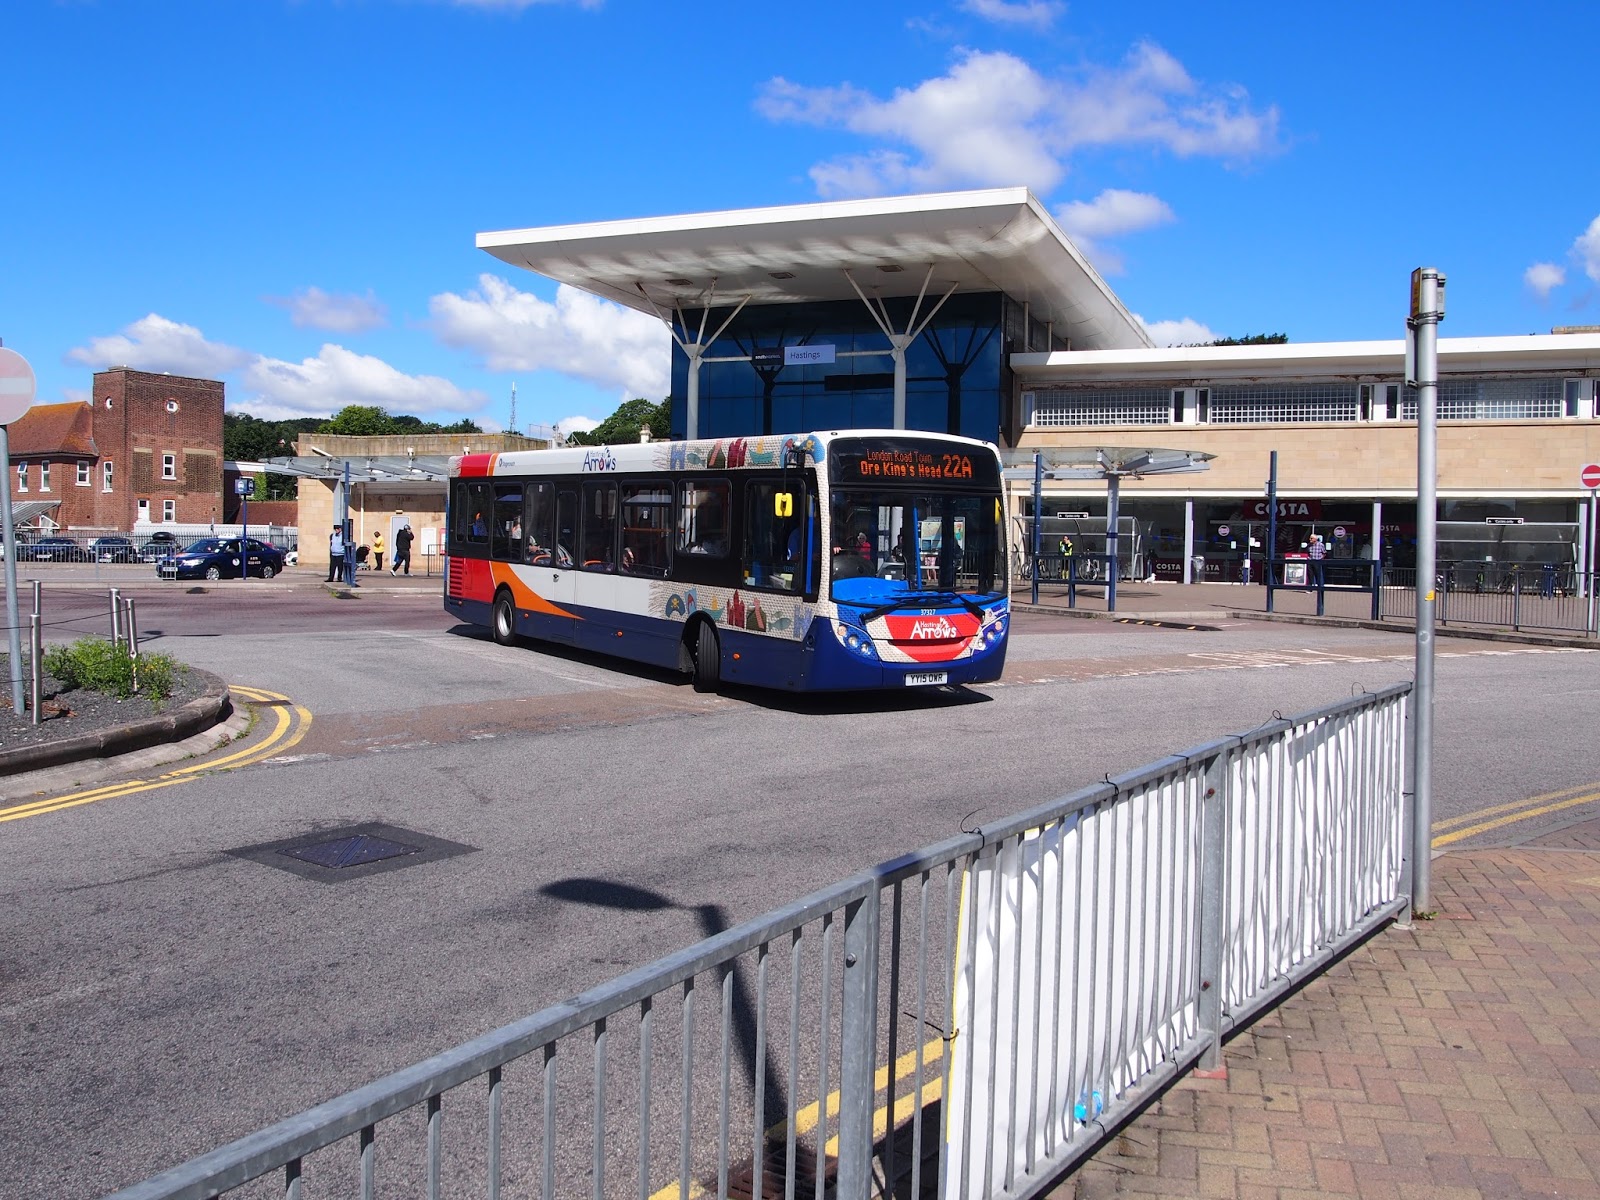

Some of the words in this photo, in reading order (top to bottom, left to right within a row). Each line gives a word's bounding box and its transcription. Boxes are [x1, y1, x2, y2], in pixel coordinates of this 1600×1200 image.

[790, 351, 821, 360] Hastings
[867, 449, 893, 461] London
[894, 450, 912, 463] Road
[860, 460, 881, 475] Ore
[882, 462, 915, 477] King's
[918, 463, 942, 478] Head
[943, 454, 972, 479] 22A
[1380, 524, 1400, 532] OSTA
[910, 620, 957, 639] Arrows
[910, 674, 927, 683] YY15
[929, 673, 943, 683] OWR
